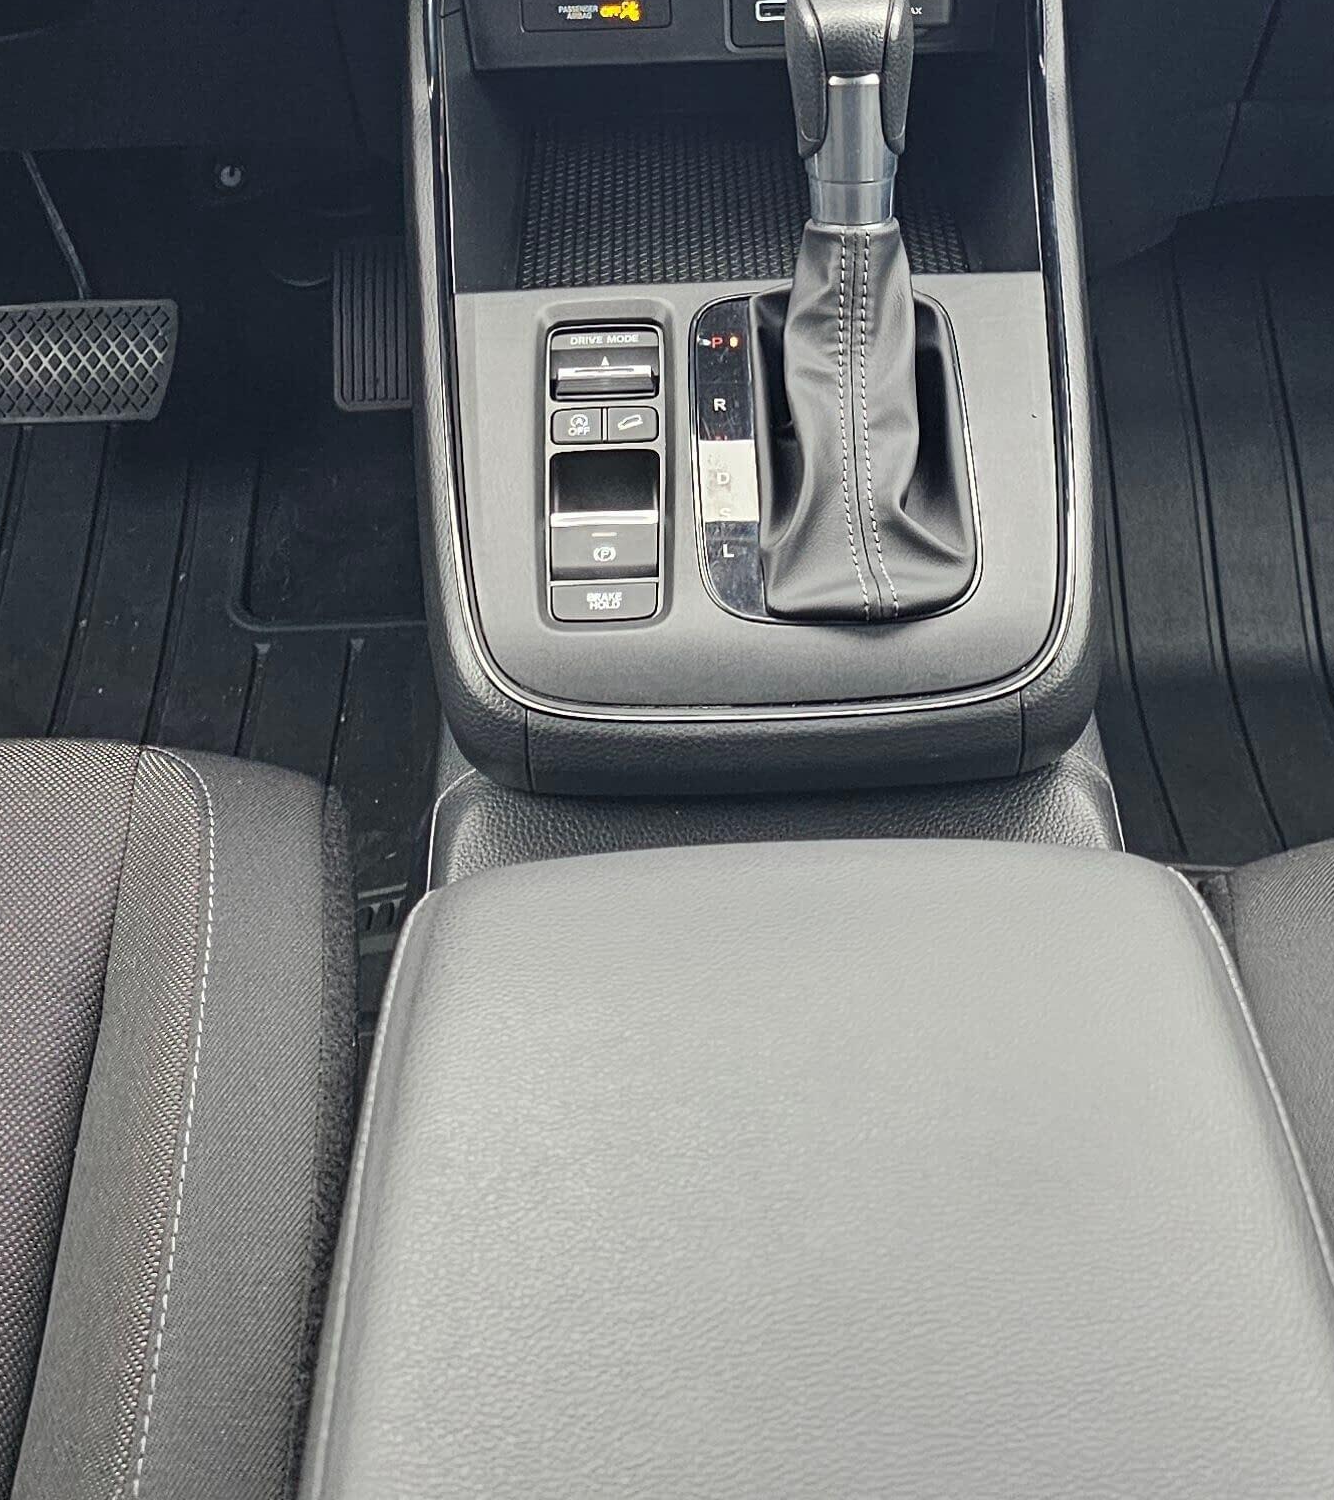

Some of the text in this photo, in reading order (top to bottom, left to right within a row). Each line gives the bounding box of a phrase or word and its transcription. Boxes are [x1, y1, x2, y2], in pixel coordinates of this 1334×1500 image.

[558, 5, 599, 14] PASSENGER
[570, 334, 639, 345] DRIVE MODE
[712, 337, 723, 349] P
[713, 398, 727, 412] R
[568, 426, 591, 436] OFF
[716, 472, 731, 486] D
[722, 543, 735, 558] L
[586, 592, 623, 602] BRAKE
[589, 601, 621, 610] HOLD
